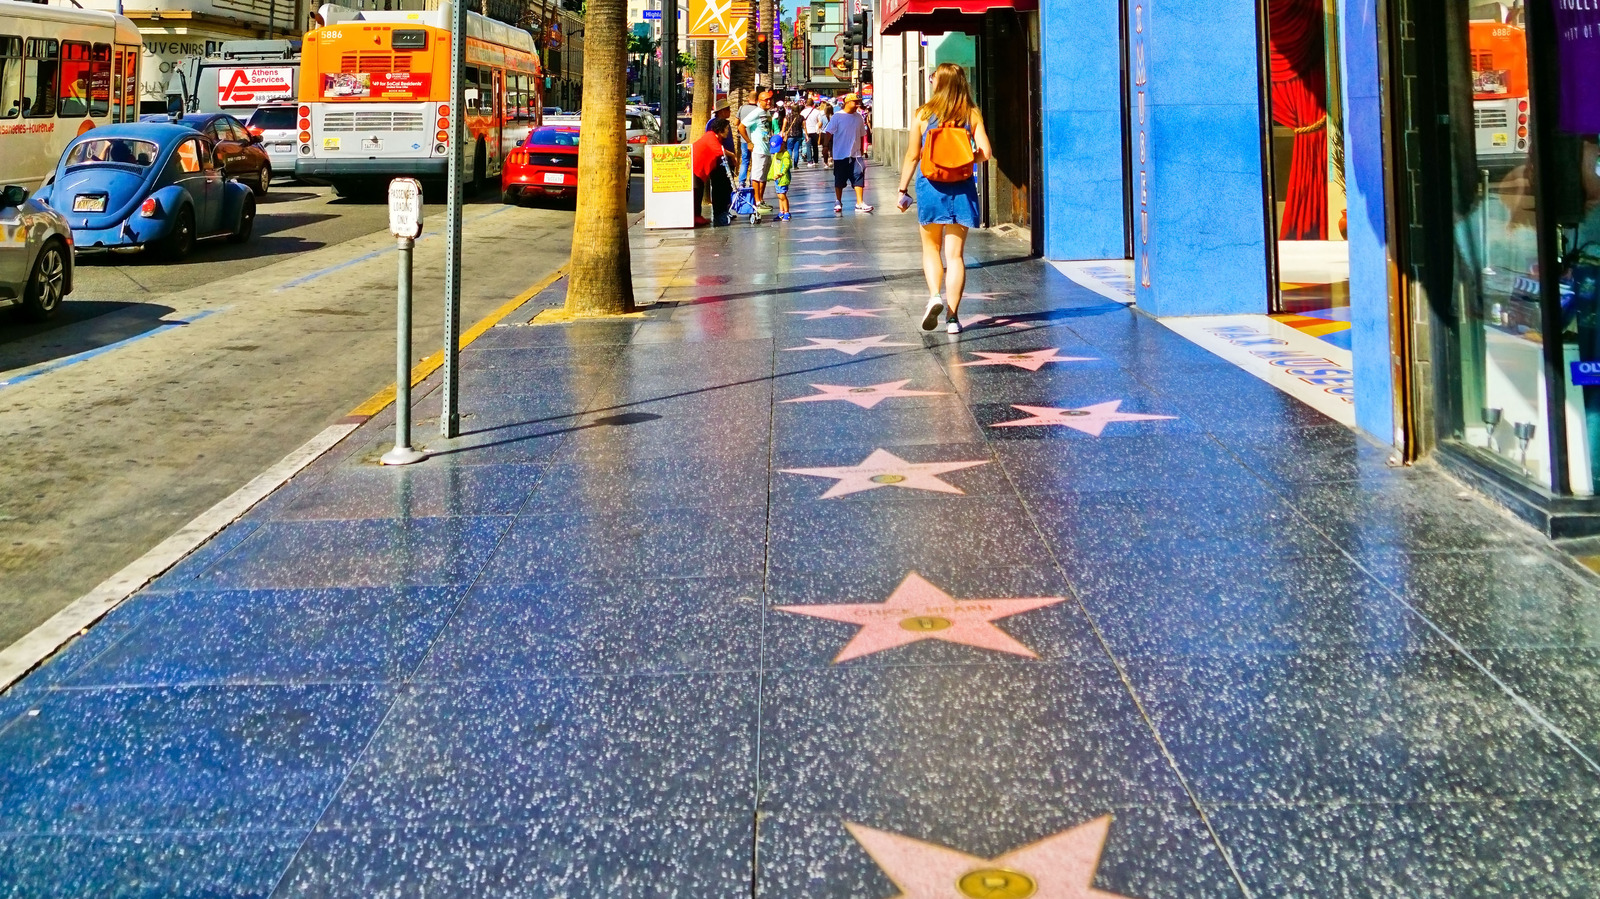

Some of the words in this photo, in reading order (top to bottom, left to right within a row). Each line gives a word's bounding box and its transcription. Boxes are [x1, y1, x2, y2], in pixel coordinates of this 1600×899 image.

[321, 30, 343, 39] 5886
[159, 62, 177, 73] OF
[1135, 40, 1150, 288] MUSEUM
[391, 189, 415, 199] PASSENGER
[393, 202, 413, 212] LOADING
[397, 214, 409, 224] ONLY
[853, 606, 911, 617] CHICK
[926, 603, 993, 614] HEARN
